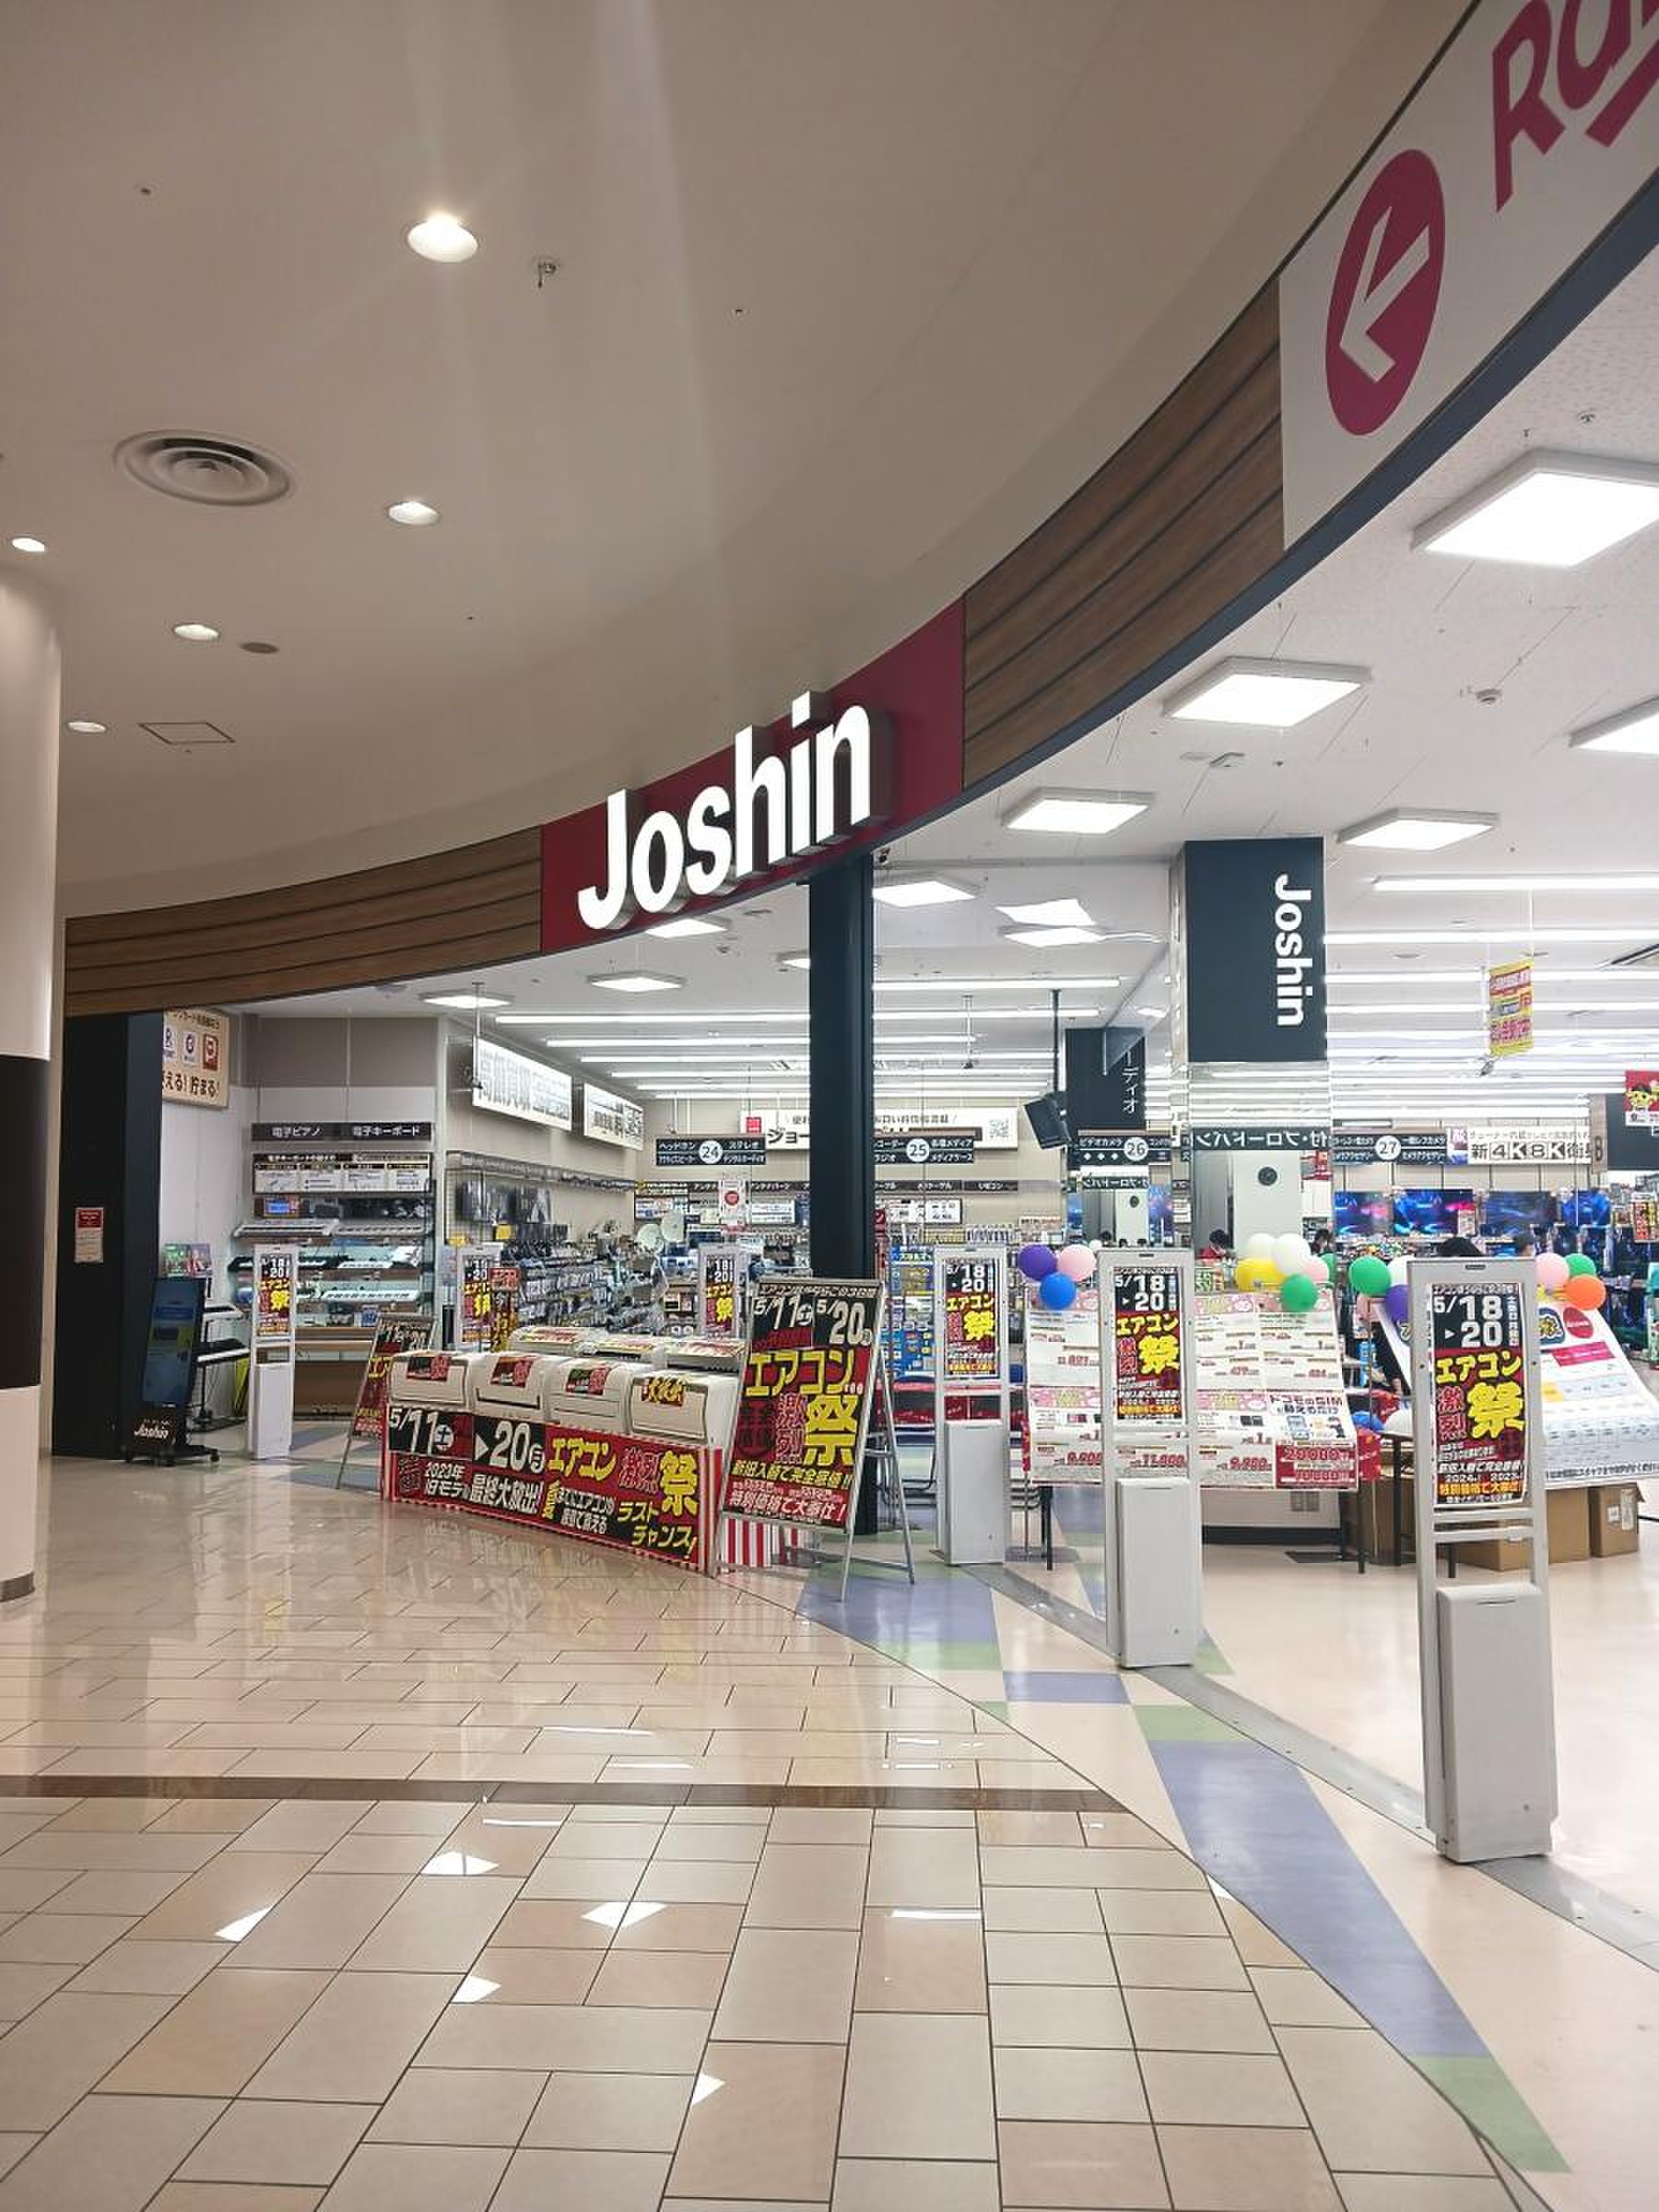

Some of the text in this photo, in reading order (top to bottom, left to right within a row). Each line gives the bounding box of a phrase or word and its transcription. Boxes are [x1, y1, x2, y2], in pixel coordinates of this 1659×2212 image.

[578, 690, 871, 930] Joshin
[1275, 874, 1313, 1028] Joshin
[700, 1145, 720, 1159] 24
[909, 1144, 928, 1157] 25
[1125, 1142, 1147, 1157] 26
[1379, 1141, 1396, 1155] 27
[961, 1278, 985, 1292] 20
[946, 1294, 994, 1312] エアコン
[1135, 1291, 1164, 1312] 20
[1433, 1295, 1503, 1321] 5/18
[817, 1298, 865, 1346] 5/20
[1116, 1312, 1179, 1335] エアコン
[1461, 1321, 1503, 1347] 20
[1138, 1335, 1181, 1374] 祭
[1435, 1350, 1522, 1384] エアコン
[745, 1349, 855, 1396] エアコン
[1466, 1382, 1525, 1439] 祭
[803, 1394, 858, 1466] 祭
[489, 1420, 530, 1471] 20
[547, 1438, 618, 1480] エアコン
[660, 1450, 699, 1516] 祭
[617, 1500, 660, 1523] ラスト
